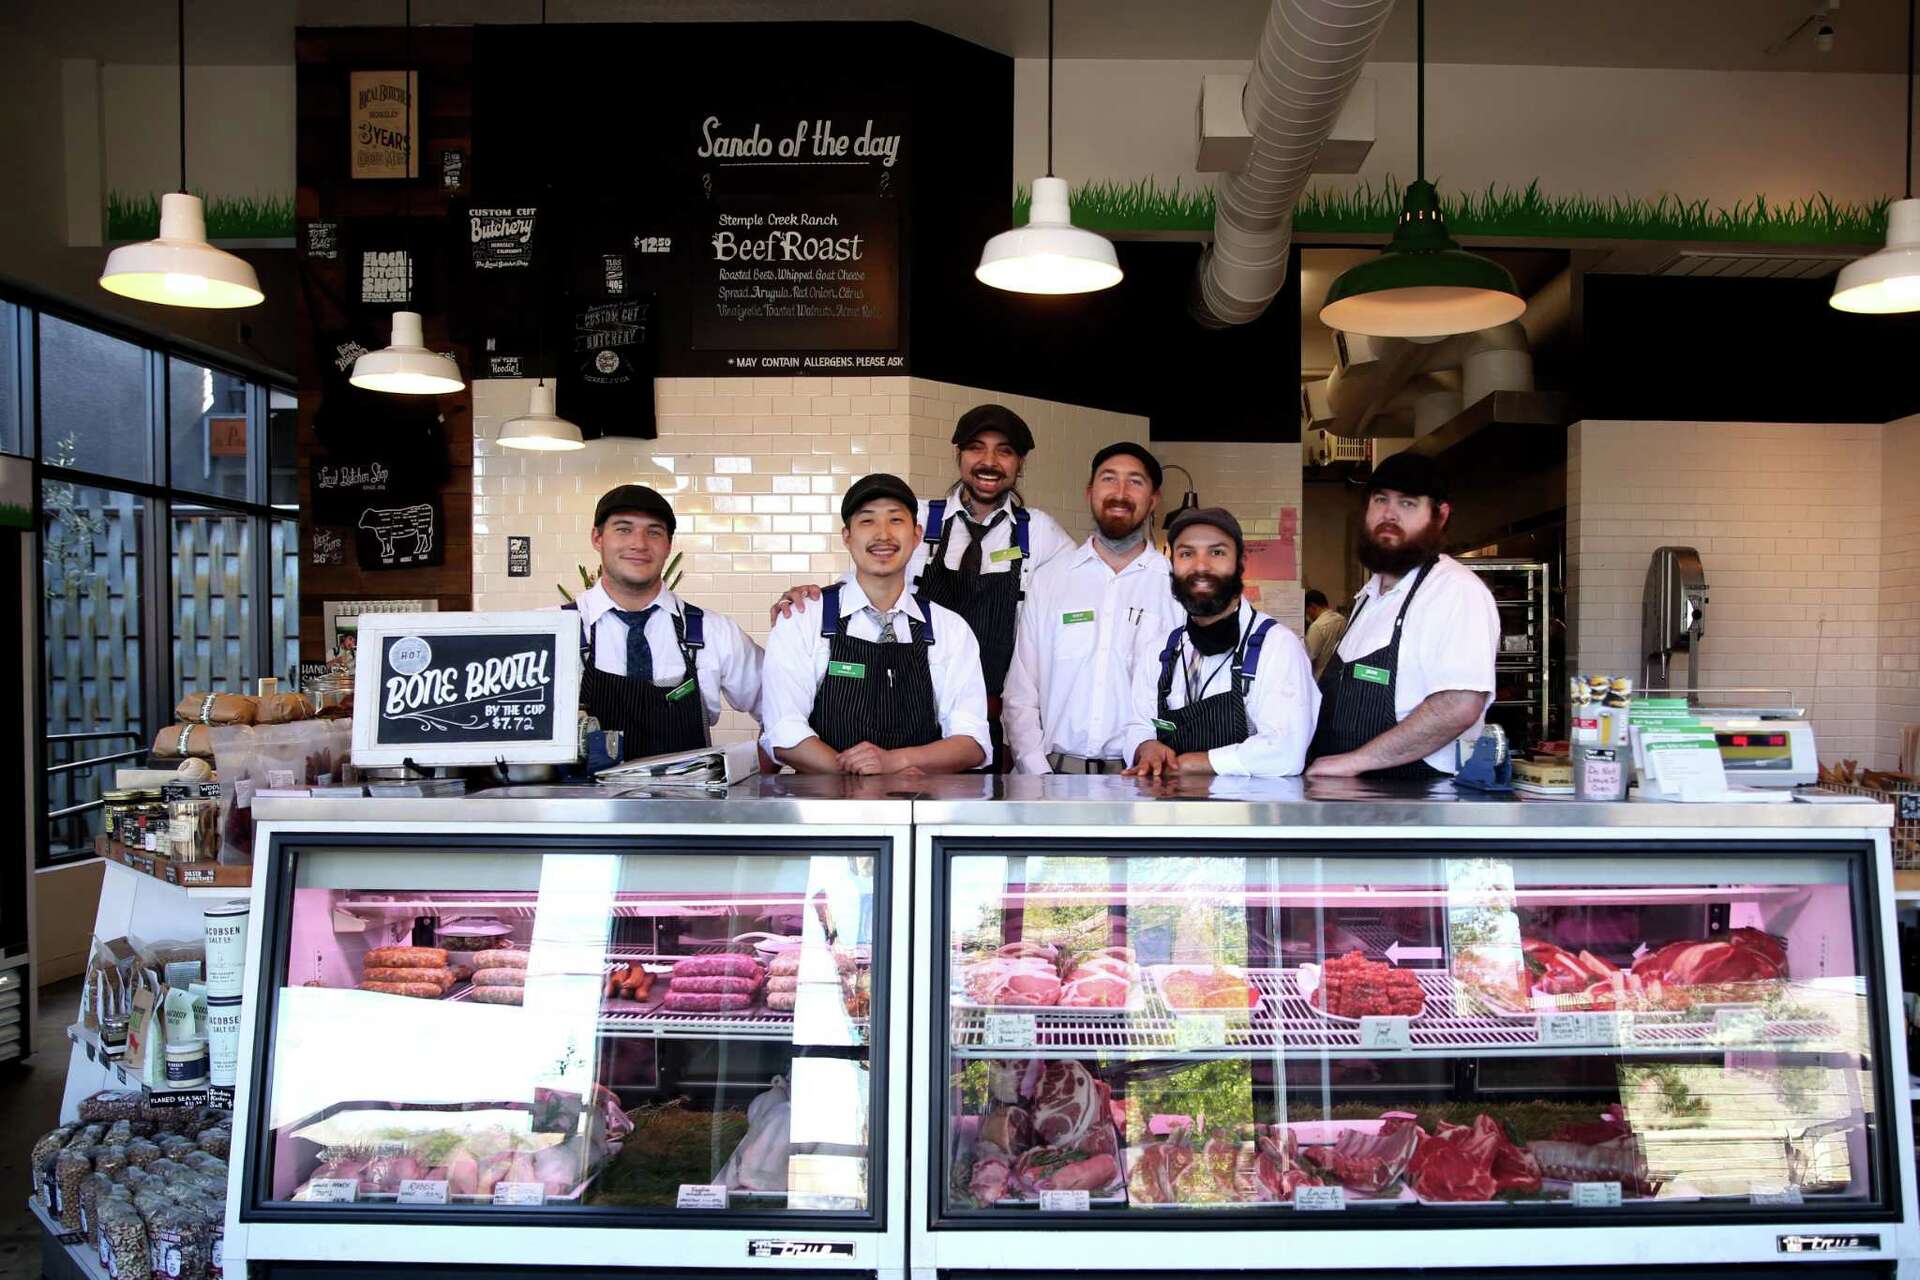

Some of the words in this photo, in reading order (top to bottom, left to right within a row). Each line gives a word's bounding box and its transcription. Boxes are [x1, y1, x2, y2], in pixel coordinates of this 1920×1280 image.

[358, 120, 373, 145] 3
[697, 116, 773, 157] Sando
[778, 120, 808, 157] of
[812, 119, 848, 157] the
[854, 119, 900, 167] day
[469, 208, 512, 217] CUSTOM
[516, 207, 537, 217] CUT
[718, 213, 764, 230] Stemple
[768, 212, 799, 226] Creek
[800, 213, 839, 226] Ranch
[470, 217, 533, 243] Butchery
[711, 231, 781, 261] Beef
[780, 231, 865, 261] Roast
[719, 267, 752, 281] Roasted
[777, 267, 814, 283] Whipped
[815, 268, 836, 281] Goat
[837, 268, 865, 281] Cheese
[737, 357, 757, 367] MAY
[762, 357, 800, 367] CONTAIN
[856, 357, 885, 367] PLEASE
[887, 357, 904, 366] ASK
[400, 651, 422, 661] HOT
[386, 666, 458, 714] BONE
[464, 649, 551, 701] BROTH
[485, 704, 501, 716] BY
[502, 704, 520, 716] THE
[523, 703, 546, 716] CUP
[492, 716, 535, 731] $7.72
[177, 1095, 191, 1103] SEA
[192, 1095, 207, 1103] SALT
